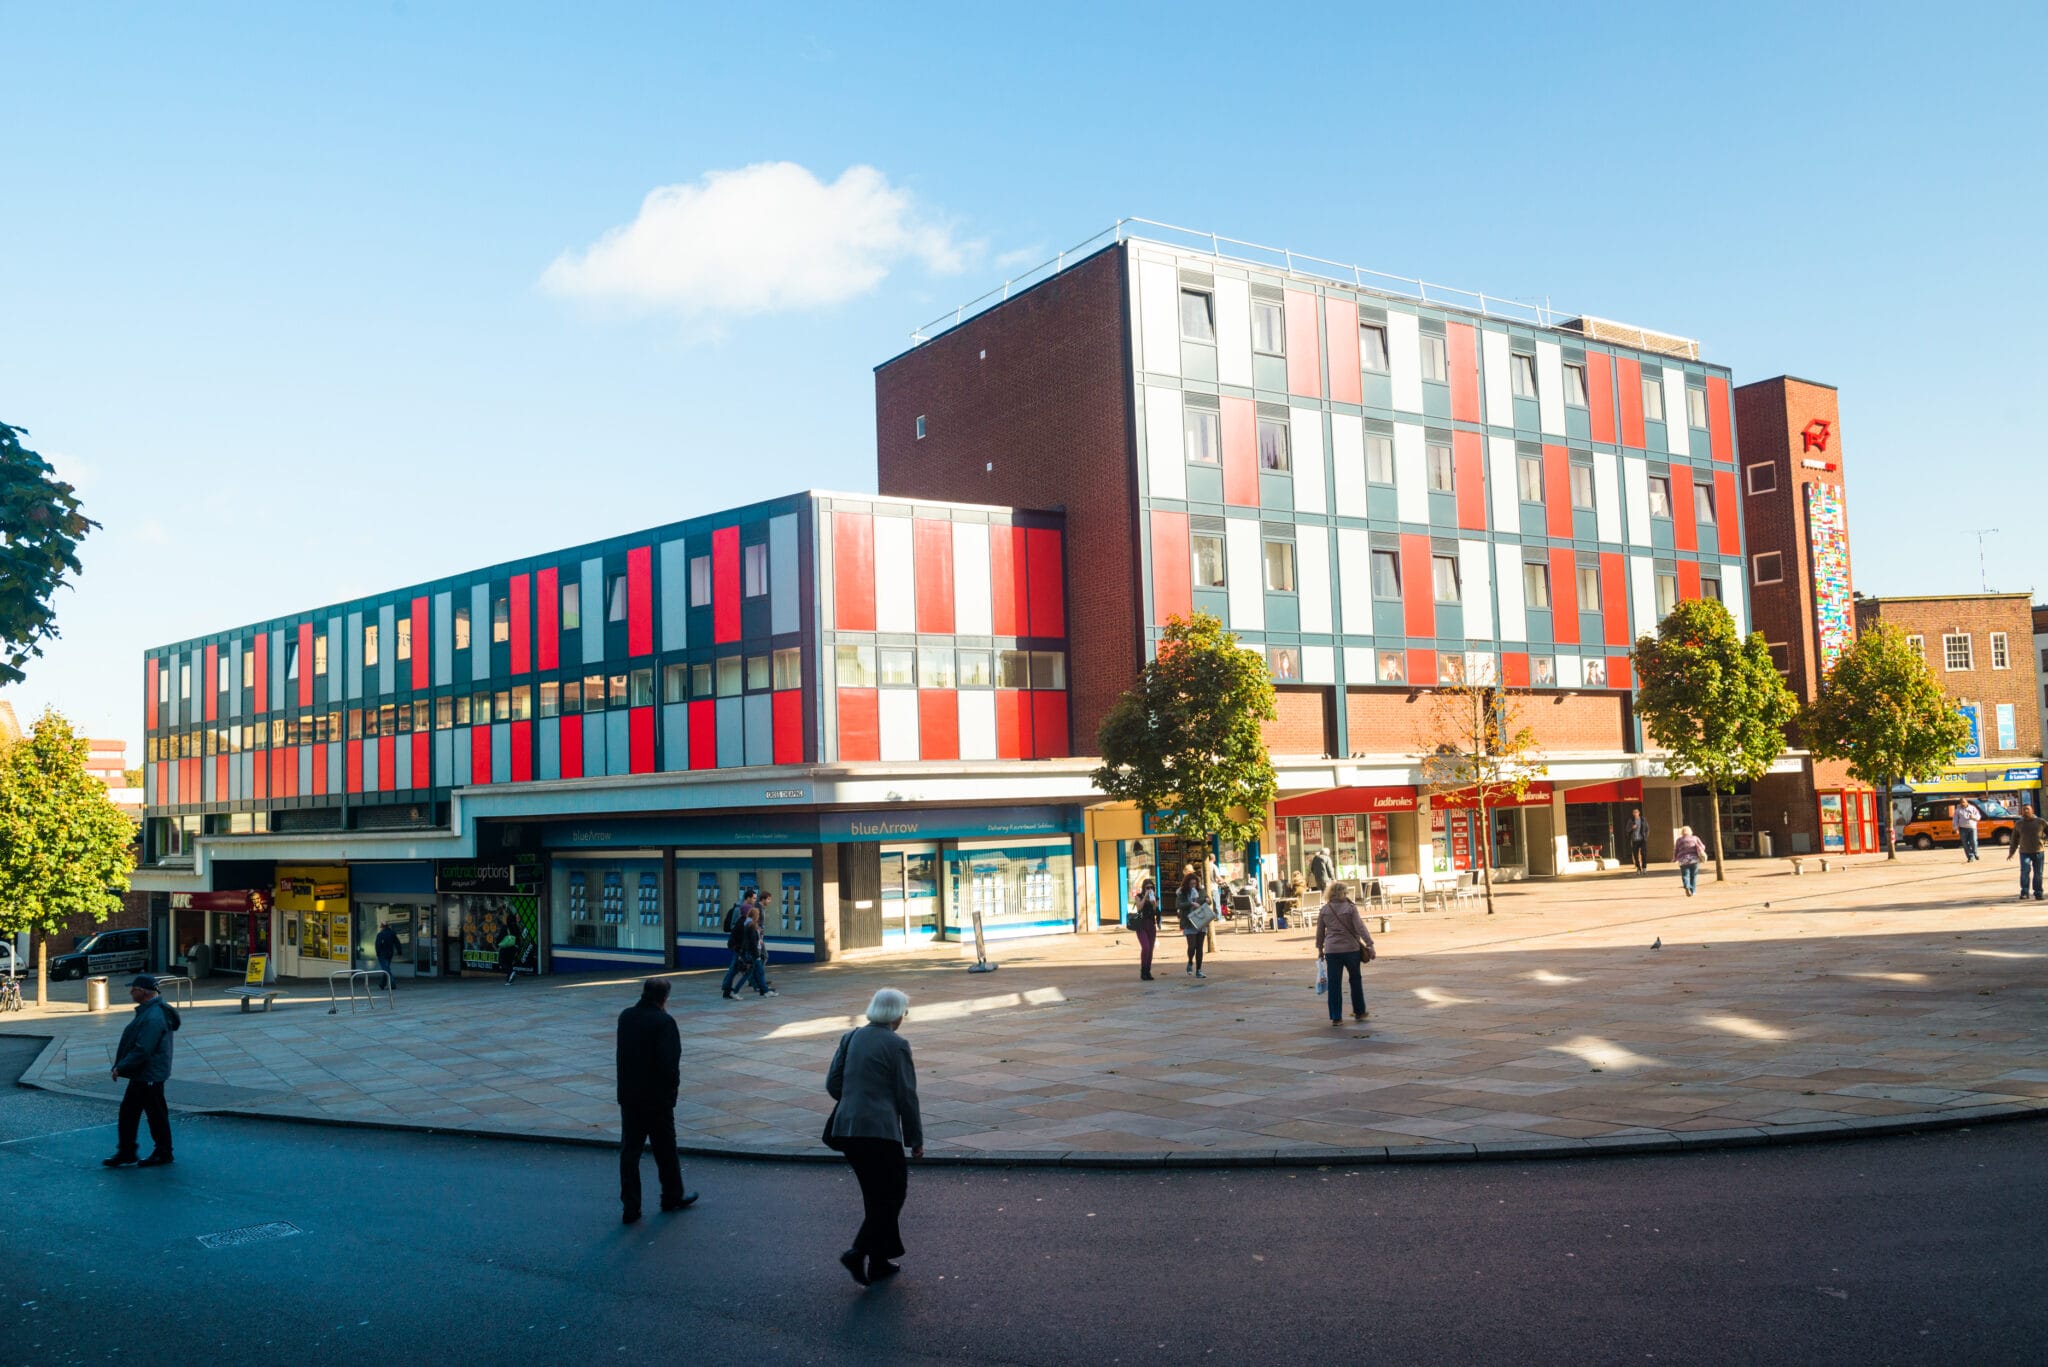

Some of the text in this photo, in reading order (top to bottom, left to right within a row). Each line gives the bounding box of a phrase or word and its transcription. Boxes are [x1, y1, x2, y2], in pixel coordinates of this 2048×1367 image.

[1373, 796, 1413, 808] Ladbrokes
[1518, 791, 1550, 801] adbrokes
[851, 821, 918, 835] blueArrow
[1304, 828, 1321, 840] TEAM
[1338, 826, 1356, 838] TEAM
[172, 894, 192, 908] KFC
